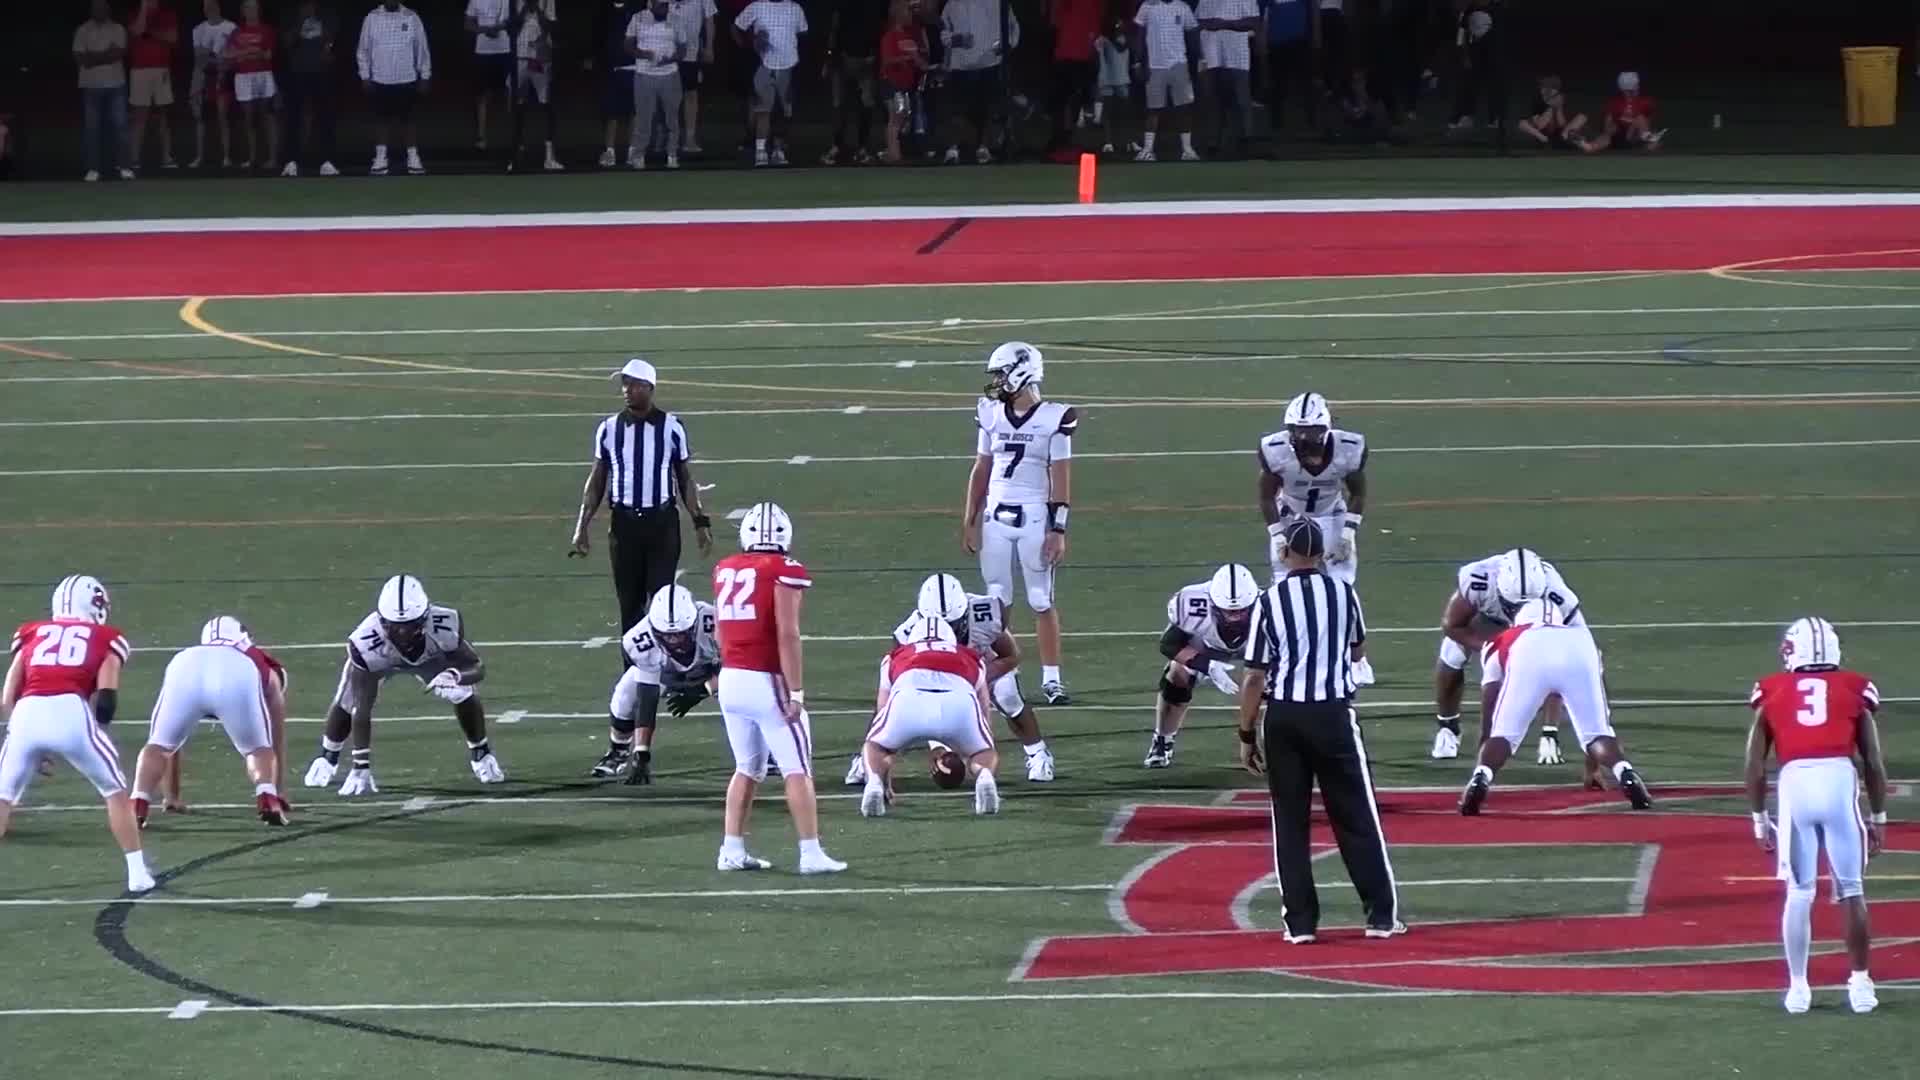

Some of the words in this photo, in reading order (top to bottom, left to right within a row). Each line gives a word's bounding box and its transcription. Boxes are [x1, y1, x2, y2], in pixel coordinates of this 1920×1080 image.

[1003, 443, 1026, 479] 7
[1305, 487, 1321, 513] 1
[1469, 572, 1488, 591] 78
[716, 567, 757, 621] 22
[973, 603, 993, 622] 50
[1188, 598, 1208, 618] 64
[432, 615, 453, 634] 74
[29, 623, 92, 668] 26
[360, 628, 385, 652] 74
[632, 631, 656, 653] 53
[1796, 677, 1828, 727] 3
